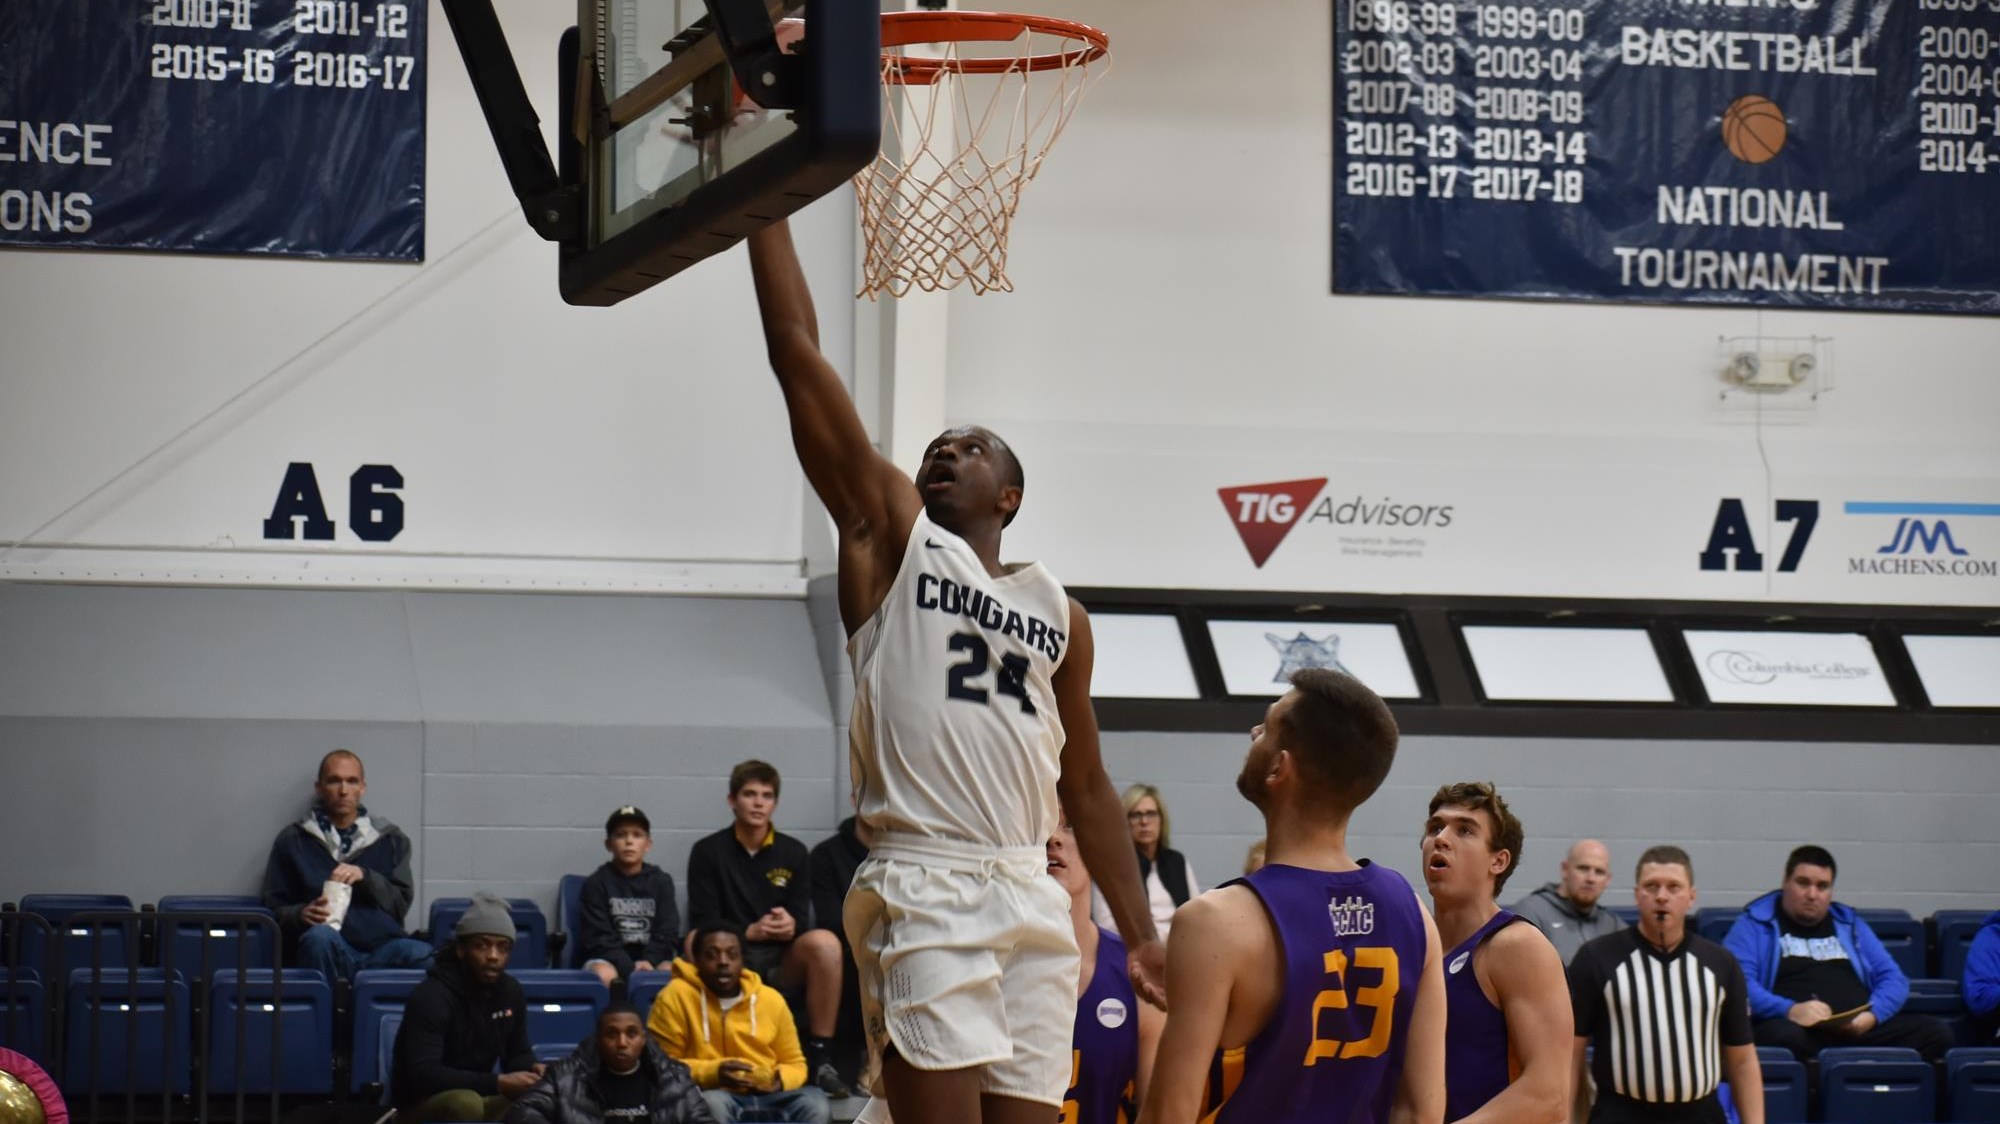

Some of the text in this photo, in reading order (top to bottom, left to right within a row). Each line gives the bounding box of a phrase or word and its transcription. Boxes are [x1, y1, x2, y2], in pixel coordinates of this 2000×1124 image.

[152, 0, 408, 38] 2010-11 2011-12
[1348, 0, 1584, 42] 1998-99 1999-00
[152, 43, 415, 91] 2015-16 2016-17
[1346, 40, 1584, 82] 2002-03 2003-04
[1621, 26, 1878, 76] BASKETBALL
[1346, 81, 1584, 124] 2007-08 2008-09
[0, 120, 113, 166] ENCE
[1346, 122, 1587, 164] 2012-13 2013-14
[1346, 162, 1584, 204] 2016-17 2017-18
[0, 190, 93, 234] ONS
[1657, 185, 1844, 231] NATIONAL
[1613, 247, 1889, 295] TOURNAMENT
[1235, 492, 1455, 528] TIG Advisors
[1847, 557, 1998, 577] MACHENS.COM
[915, 571, 1066, 664] COUGARS
[945, 630, 1039, 717] 24
[1332, 906, 1374, 937] CAC
[1302, 946, 1400, 1067] 23
